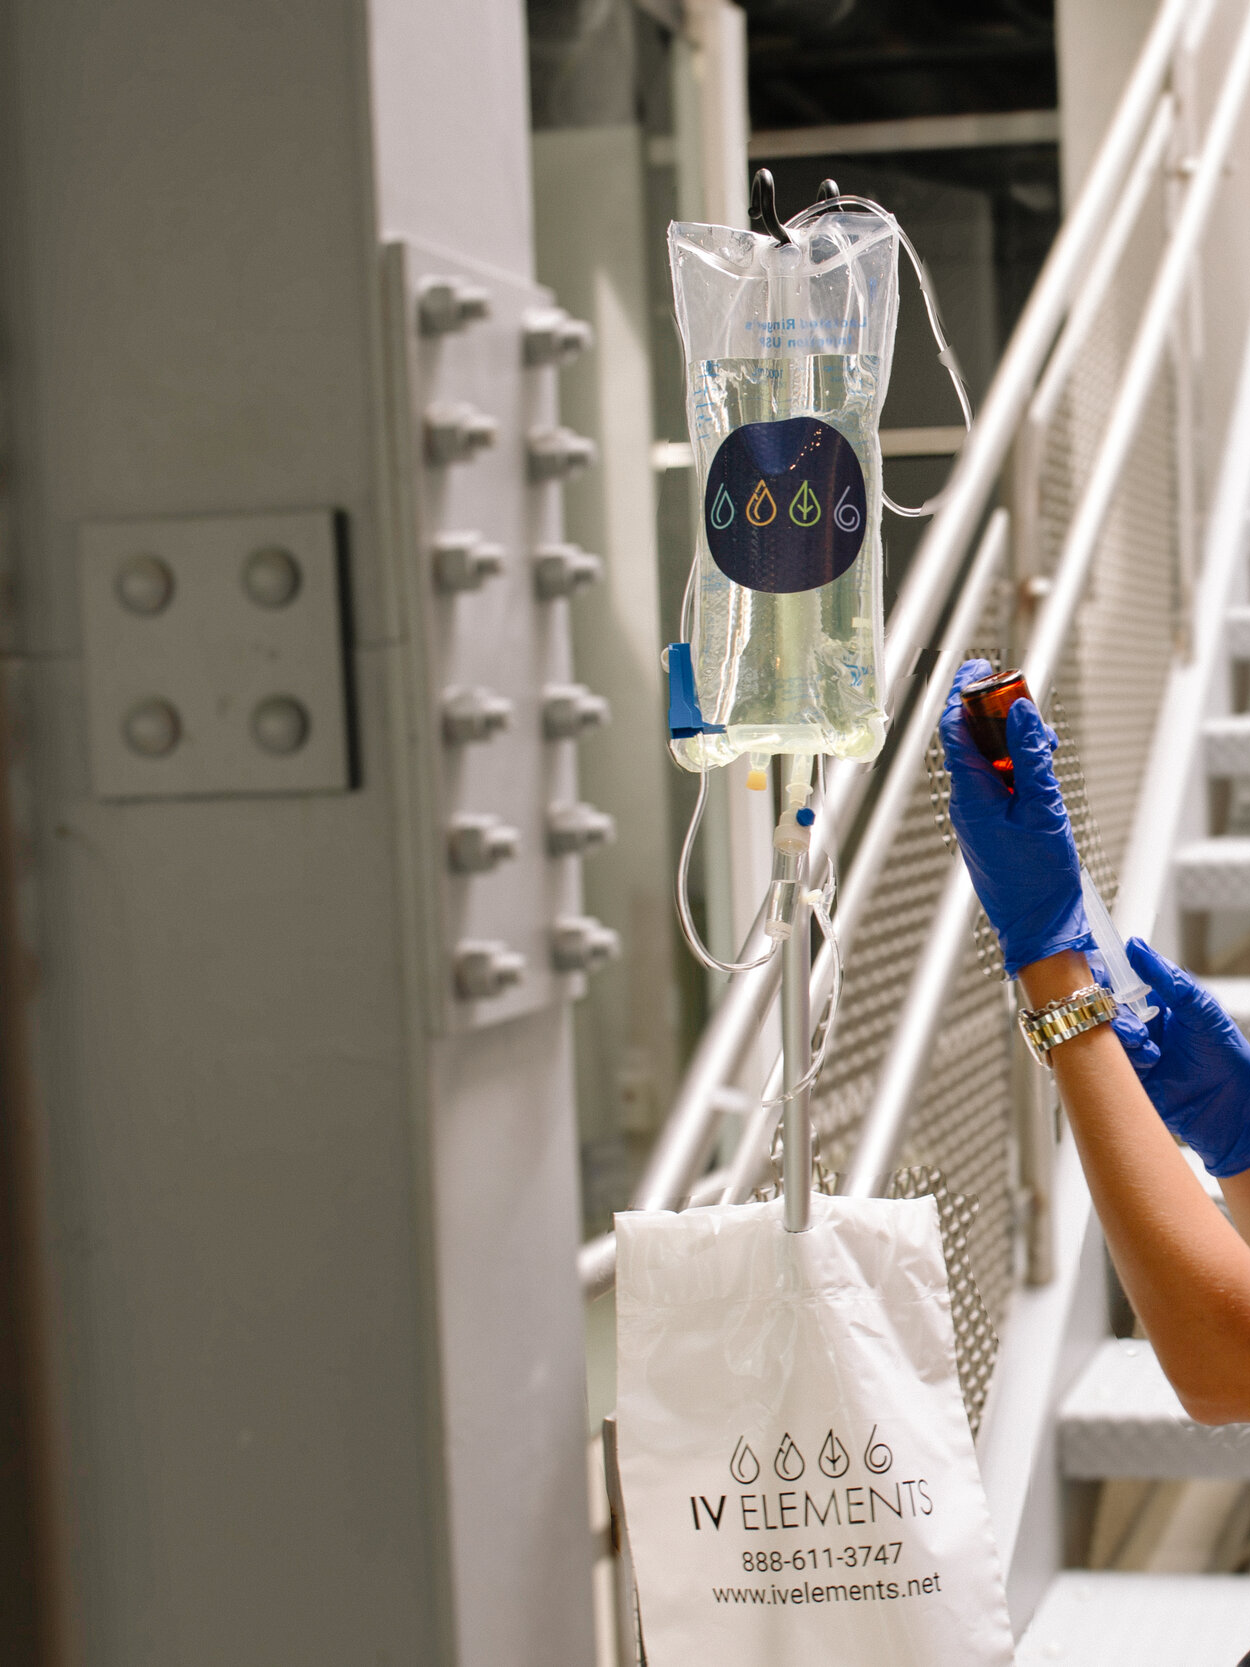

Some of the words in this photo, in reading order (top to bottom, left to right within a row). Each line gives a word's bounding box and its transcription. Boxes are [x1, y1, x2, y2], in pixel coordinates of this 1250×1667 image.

[690, 1495, 727, 1531] IV
[740, 1479, 934, 1531] ELEMENTS
[742, 1542, 904, 1573] 888-611-3747
[712, 1572, 942, 1606] www.ivelements.net
